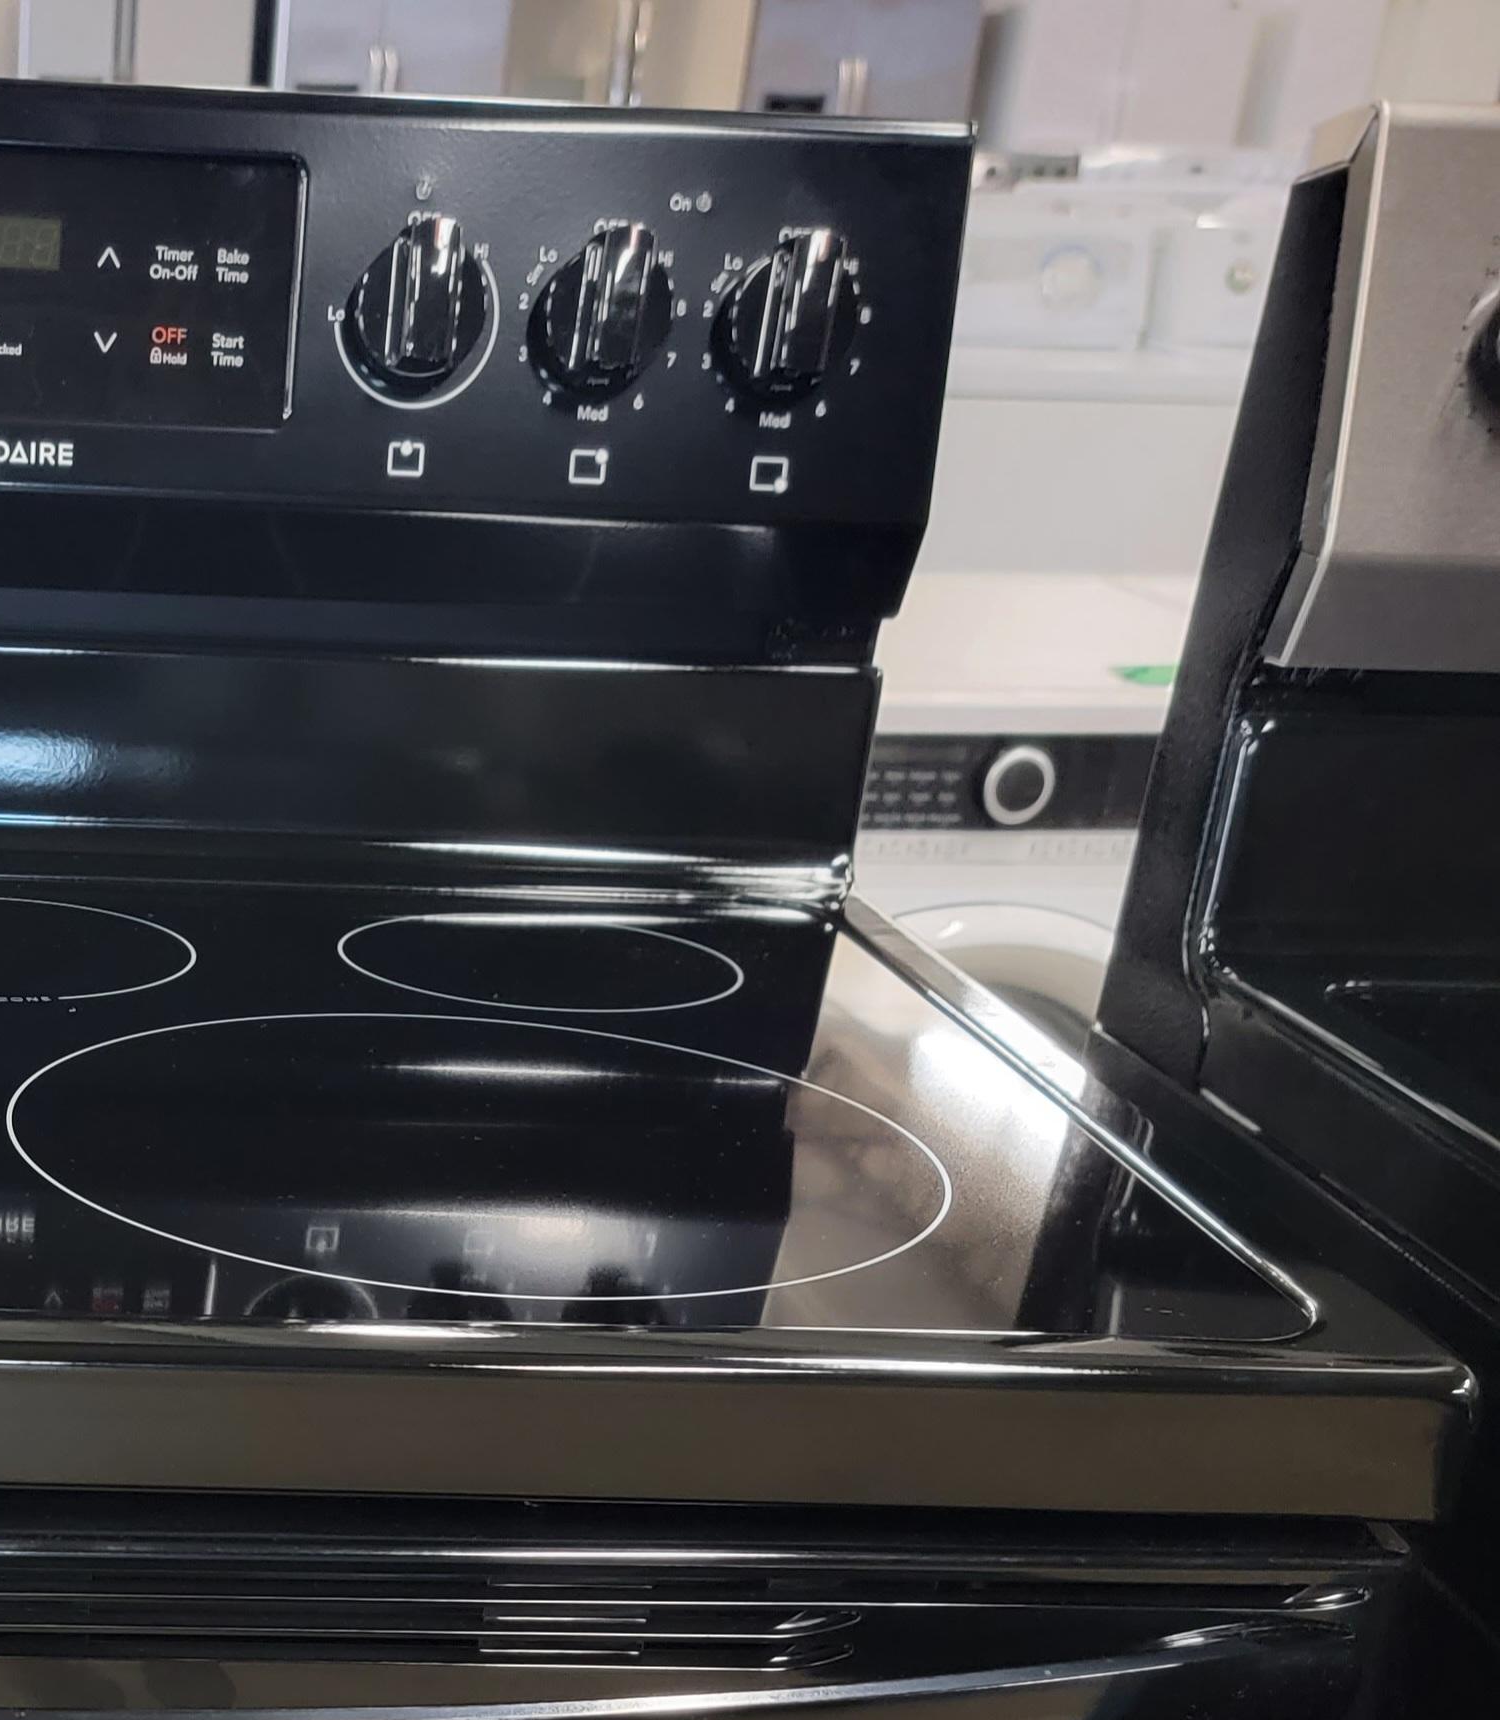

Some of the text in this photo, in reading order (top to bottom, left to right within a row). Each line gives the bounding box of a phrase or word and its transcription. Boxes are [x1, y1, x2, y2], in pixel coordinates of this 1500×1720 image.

[670, 192, 692, 212] On
[155, 245, 194, 262] Timer
[217, 247, 250, 265] Bake
[539, 245, 558, 263] Lo
[724, 253, 743, 271] Lo
[150, 263, 199, 281] On-Off
[216, 266, 249, 284] Time
[518, 292, 529, 310] 2
[702, 299, 714, 318] 2
[327, 305, 345, 321] Lo
[151, 326, 188, 344] OFF
[212, 332, 245, 349] Start
[163, 352, 188, 365] Hold
[211, 351, 244, 367] Time
[518, 345, 528, 363] 3
[666, 351, 677, 369] 7
[701, 352, 711, 370] 3
[849, 357, 861, 376] 7
[542, 390, 552, 406] 4
[633, 392, 644, 410] 6
[724, 397, 735, 414] 4
[577, 404, 609, 423] Med
[815, 399, 827, 418] 6
[759, 410, 792, 430] Med
